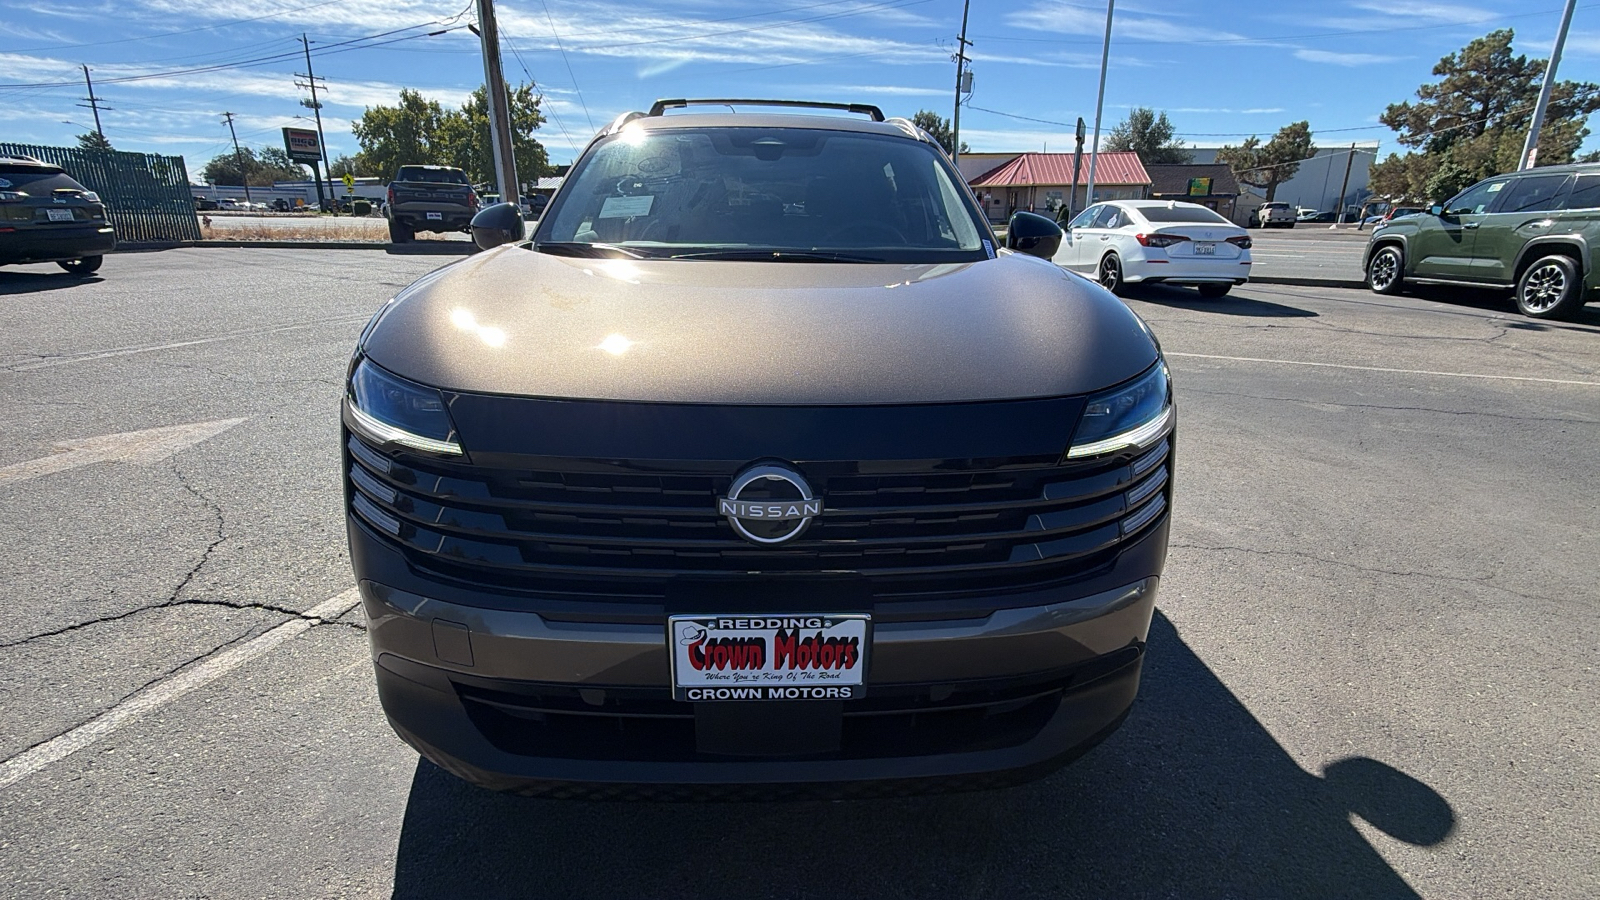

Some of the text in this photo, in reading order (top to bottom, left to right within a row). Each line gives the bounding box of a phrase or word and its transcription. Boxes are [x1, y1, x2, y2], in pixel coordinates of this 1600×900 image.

[396, 191, 467, 199] FORD
[722, 502, 818, 517] NISSAN
[719, 619, 822, 629] REDDING
[688, 629, 860, 671] Crown Motors
[732, 672, 760, 683] You're
[787, 672, 797, 681] Of
[801, 671, 815, 680] The
[687, 687, 852, 700] CROWN MOTORS
